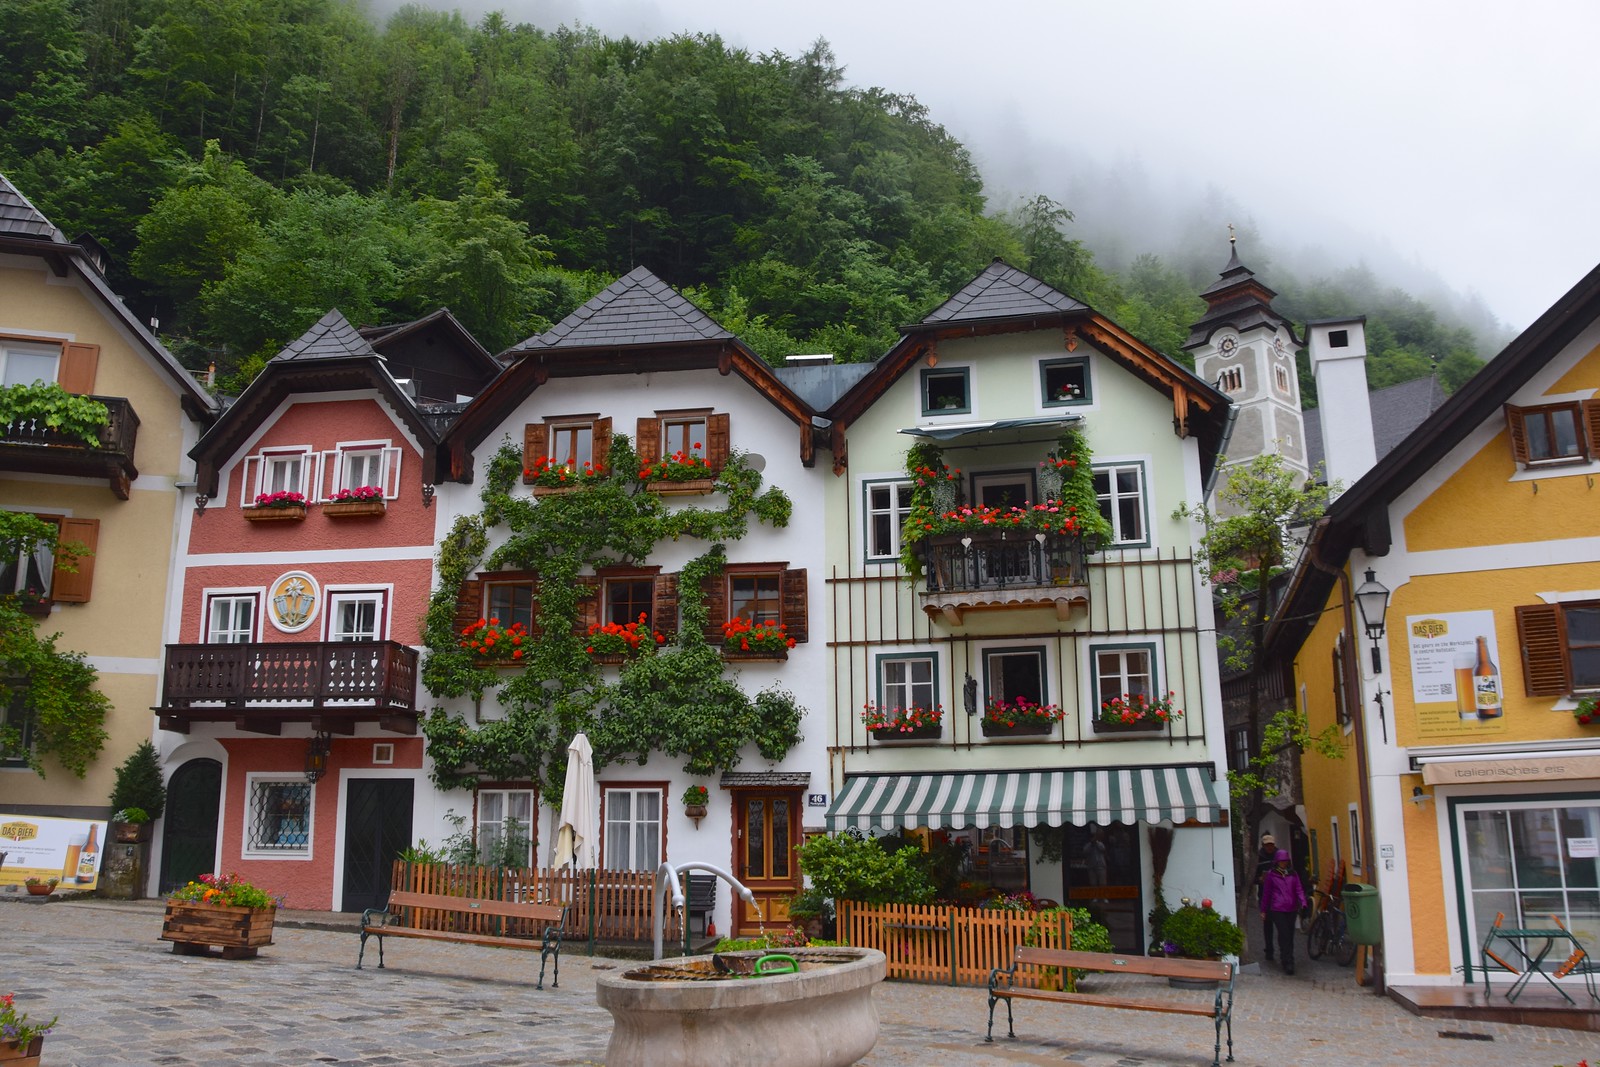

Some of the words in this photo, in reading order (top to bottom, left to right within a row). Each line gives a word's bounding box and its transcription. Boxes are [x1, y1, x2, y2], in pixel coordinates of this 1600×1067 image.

[1413, 625, 1427, 635] DAS
[1454, 765, 1540, 778] italienisches
[1544, 765, 1565, 774] eis
[811, 795, 823, 803] 46
[2, 826, 16, 836] DAS
